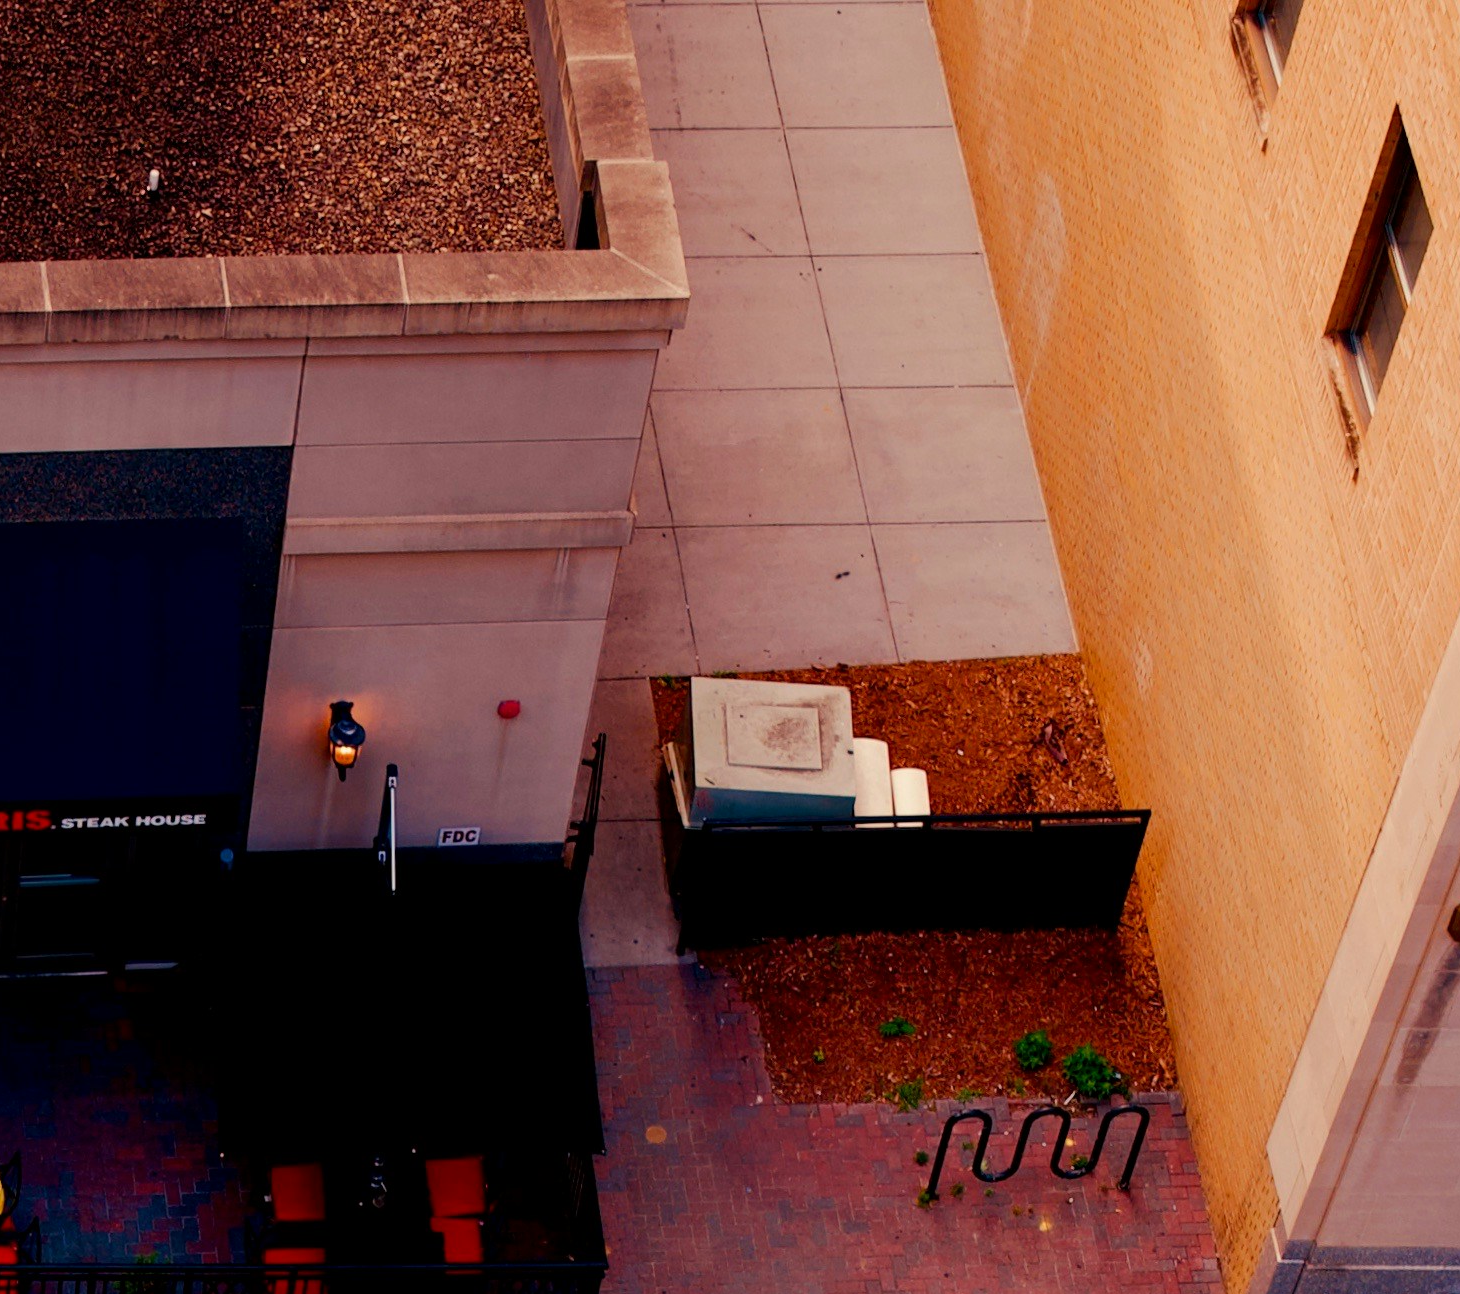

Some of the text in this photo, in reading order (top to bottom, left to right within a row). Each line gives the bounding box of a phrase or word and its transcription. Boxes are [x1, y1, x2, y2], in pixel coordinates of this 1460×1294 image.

[61, 816, 129, 829] STEAK
[135, 813, 207, 827] HOUSE
[441, 829, 478, 845] FDC
